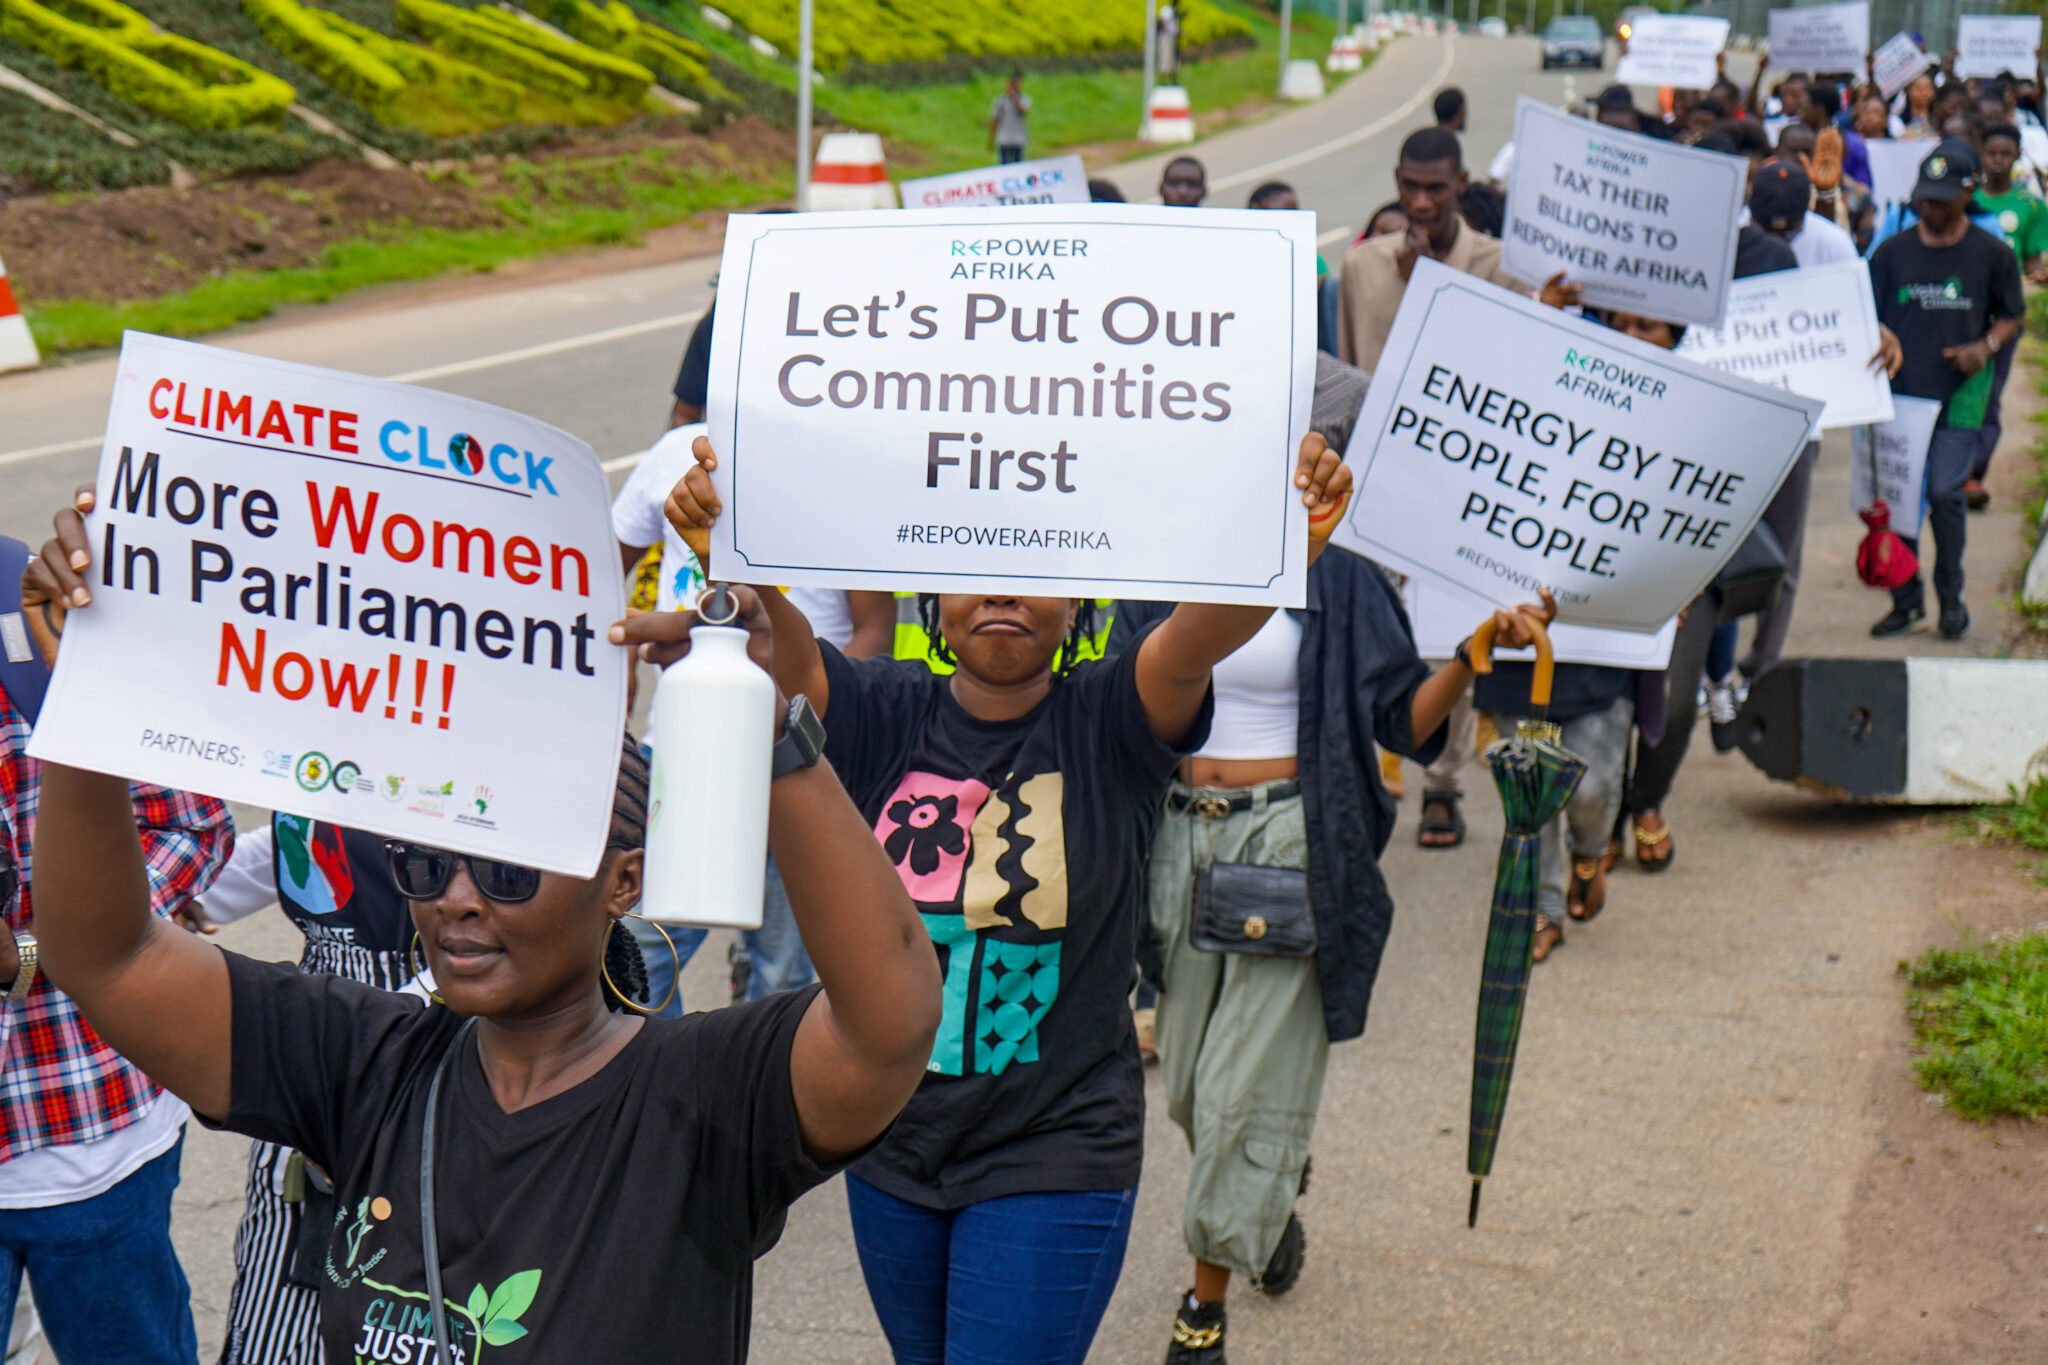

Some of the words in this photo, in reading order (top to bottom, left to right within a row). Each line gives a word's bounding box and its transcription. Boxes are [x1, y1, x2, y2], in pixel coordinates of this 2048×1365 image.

[1586, 156, 1631, 177] AFRIKA
[1587, 139, 1648, 166] REPOWER
[922, 180, 997, 206] CLIMATE
[1002, 169, 1066, 193] CLOCK
[1553, 163, 1593, 196] TAX
[1599, 178, 1669, 216] THEIR
[951, 238, 1088, 257] REPOWER
[1538, 194, 1634, 243] BILLIONS
[1642, 225, 1677, 252] TO
[950, 262, 1055, 280] AFRIKA
[1512, 217, 1608, 272] REPOWER
[1614, 254, 1708, 291] AFRIKA
[786, 290, 938, 340] Let’s
[964, 293, 1079, 343] Put
[1102, 296, 1235, 347] Our
[1681, 330, 1726, 351] et's
[1734, 317, 1779, 343] Put
[1787, 309, 1842, 335] Our
[1564, 347, 1667, 400] REPOWER
[1706, 336, 1848, 374] mmunities
[777, 353, 1232, 422] Communities
[1555, 371, 1633, 413] AFRIKA
[149, 376, 360, 455] CLIMATE
[378, 419, 560, 497] CLOCK
[1422, 364, 1594, 456] ENERGY
[1598, 436, 1662, 480] BY
[1671, 458, 1746, 507] THE
[926, 431, 1078, 494] First
[1389, 405, 1549, 502] PEOPLE,
[1561, 482, 1651, 534] FOR
[1658, 508, 1732, 552] THE
[109, 445, 280, 538] More
[305, 480, 591, 598] Women
[896, 524, 1112, 551] #REPOWERAFRIKA
[1460, 492, 1621, 580] PEOPLE.
[102, 522, 161, 596] In
[190, 539, 596, 677] Parliament
[217, 621, 456, 731] Now!!!
[140, 729, 246, 767] PARTNERS:
[364, 1298, 465, 1346] CLIMTE
